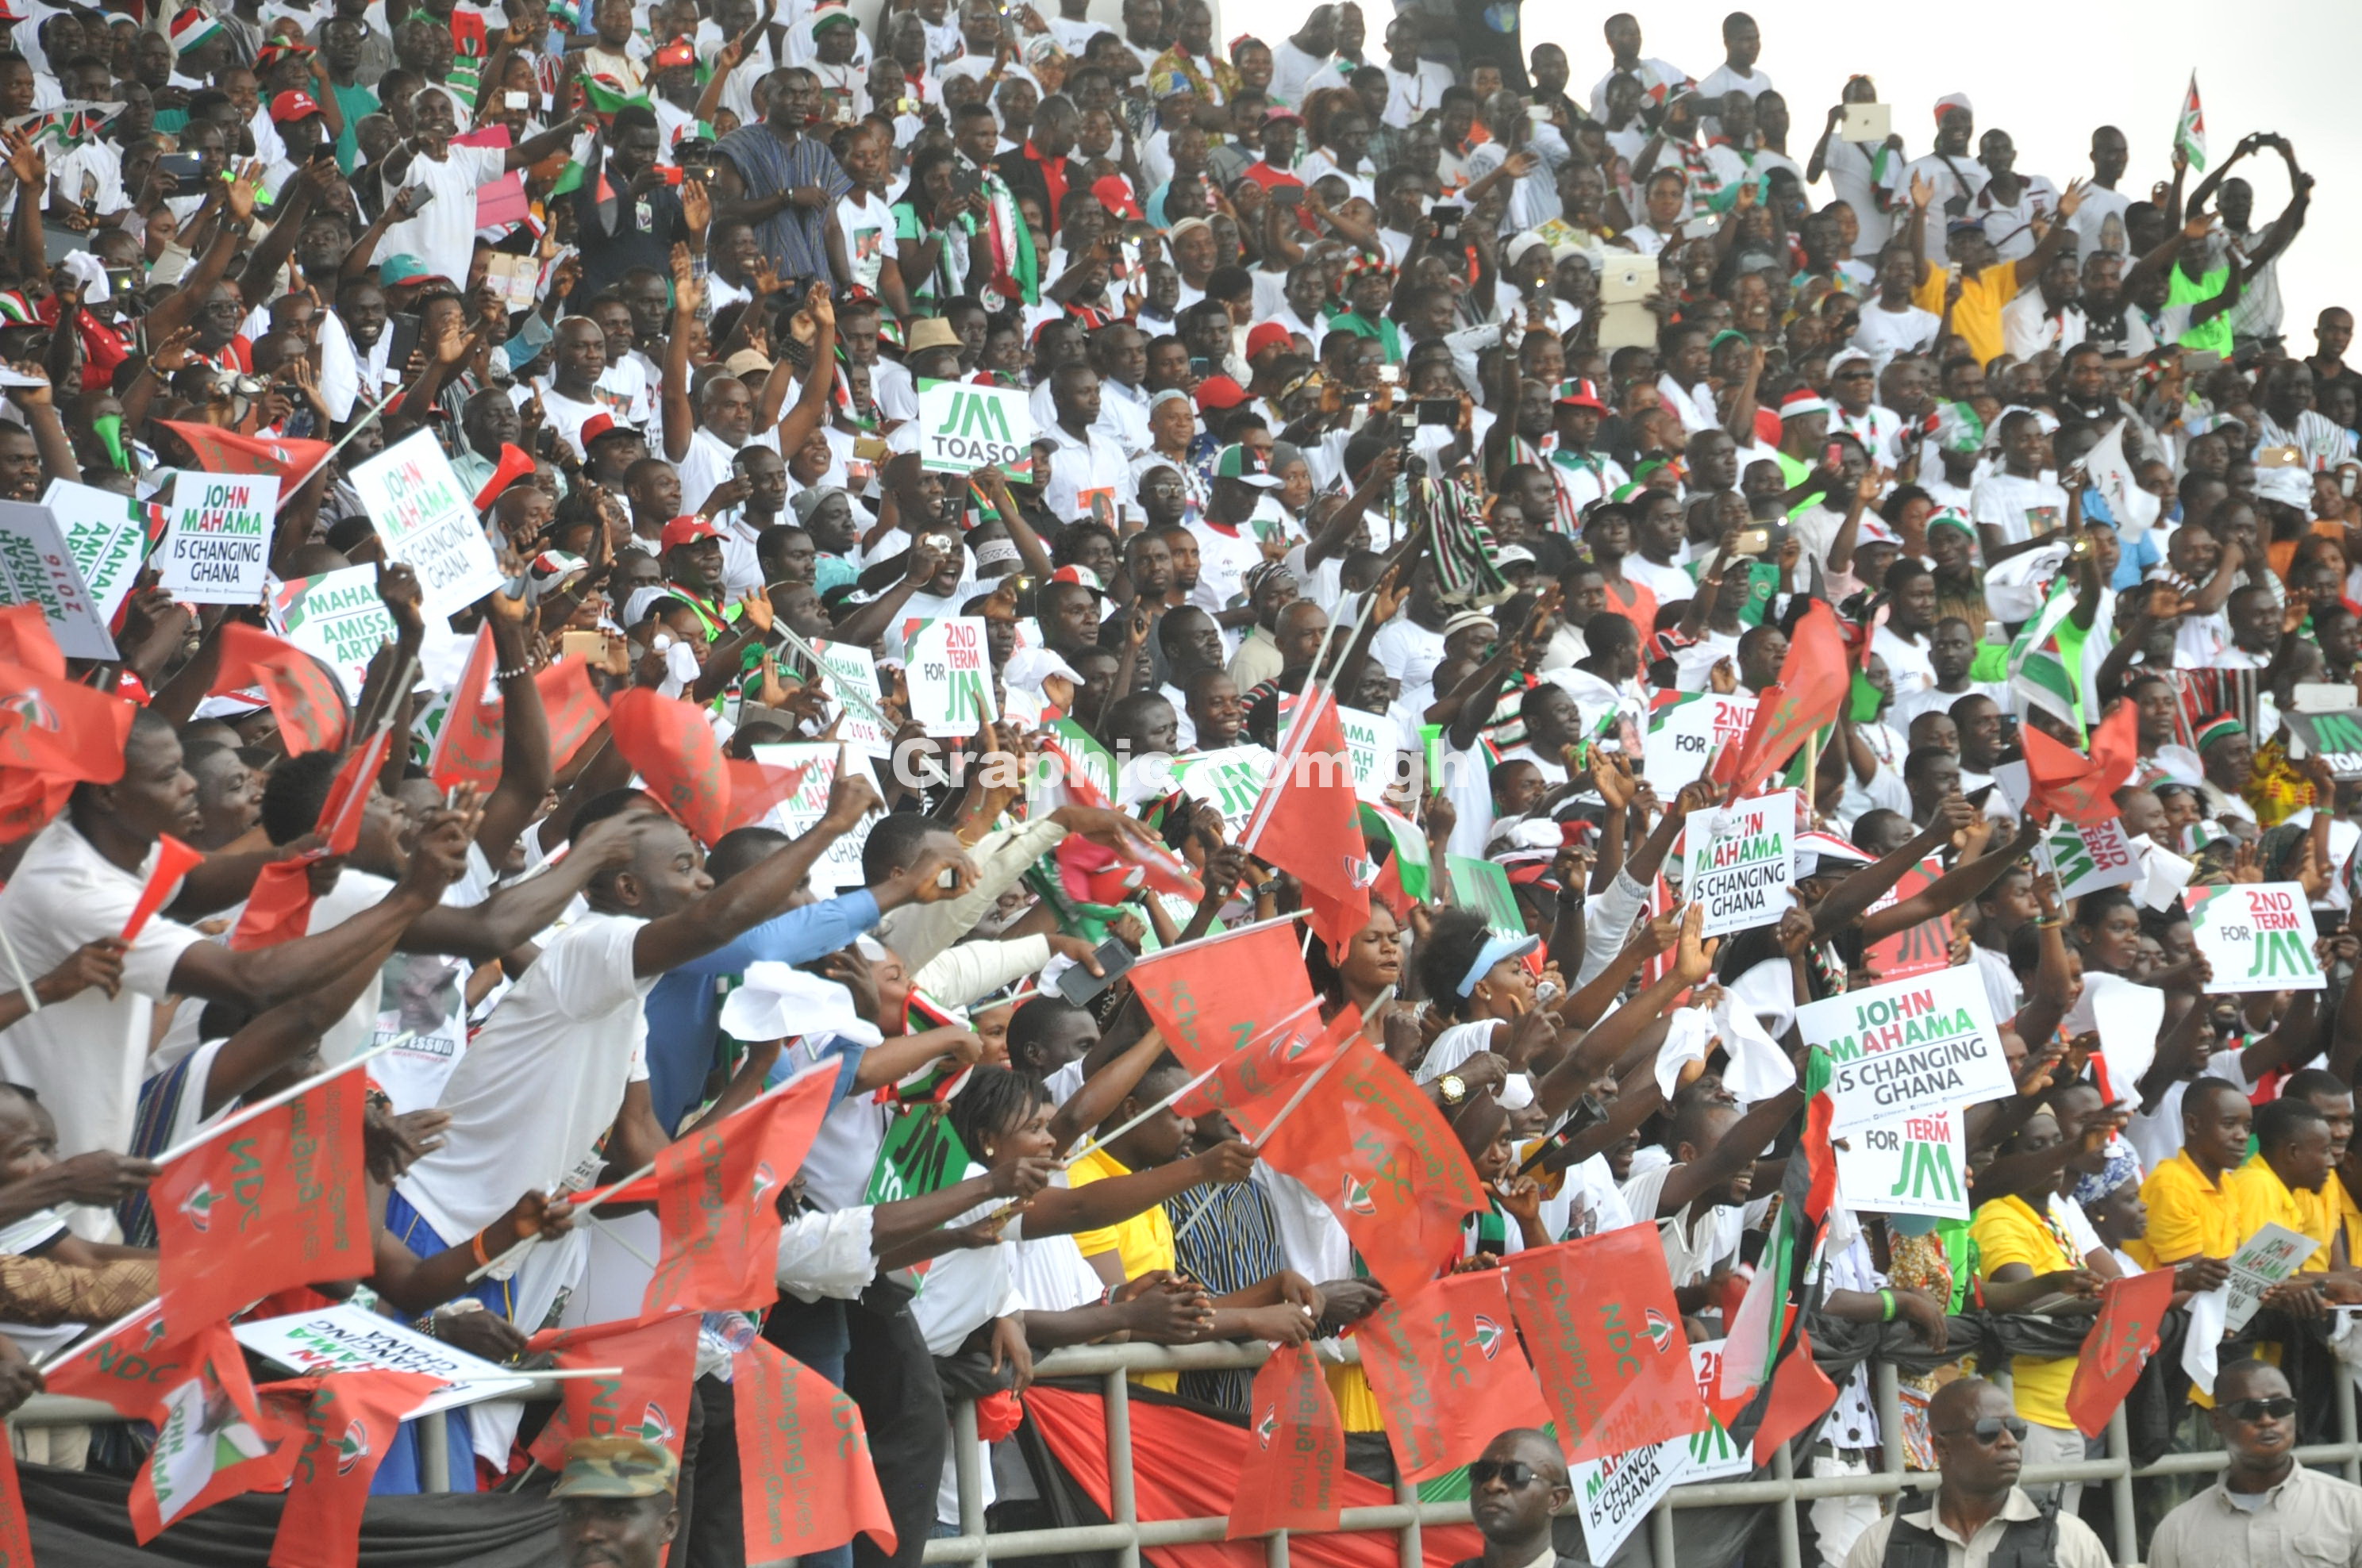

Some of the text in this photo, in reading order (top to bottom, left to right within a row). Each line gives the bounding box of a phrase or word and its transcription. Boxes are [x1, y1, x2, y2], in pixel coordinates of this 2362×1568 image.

[938, 391, 1012, 443] JM
[932, 436, 1020, 463] TOASO
[203, 485, 249, 509] JOHN
[382, 459, 425, 502] JOHN
[180, 509, 261, 535] MAHAMA
[383, 481, 456, 540] MAHAMA
[174, 539, 261, 563] IS CHANGING
[411, 515, 474, 566] CHANGING
[15, 536, 66, 621] ARTHUR
[44, 555, 83, 613] 2016
[190, 562, 240, 583] GHANA
[429, 551, 472, 590] GHANA
[308, 583, 383, 615] MAHA
[944, 623, 976, 648] 2ND
[924, 663, 946, 681] FOR
[946, 649, 980, 670] TERM
[945, 671, 994, 722] JM
[849, 721, 875, 741] 2016
[1675, 734, 1706, 753] FOR
[1692, 863, 1785, 901] IS CHANGING
[1712, 889, 1765, 917] GHANA
[2245, 891, 2292, 912] 2ND
[2221, 926, 2252, 941] FOR
[2251, 913, 2300, 930] TERM
[2248, 930, 2317, 978] JM
[1856, 990, 1935, 1031] JOHN
[1829, 1008, 1975, 1063] MAHAMA
[1837, 1038, 1987, 1093] IS CHANGING
[1875, 1068, 1964, 1105] GHANA
[1866, 1130, 1900, 1151] FOR
[1904, 1118, 1952, 1143] TERM
[1891, 1141, 1961, 1202] JM
[2235, 1249, 2289, 1281] MAHAMA
[2261, 1238, 2299, 1260] JOHN
[367, 1329, 459, 1372] GHANA
[1433, 1312, 1471, 1390] NDC
[1599, 1302, 1641, 1378] NDC
[86, 1340, 179, 1383] NDC
[590, 1379, 621, 1439] ND
[1611, 1462, 1662, 1525] GHANA
[1590, 1505, 1603, 1528] IS
